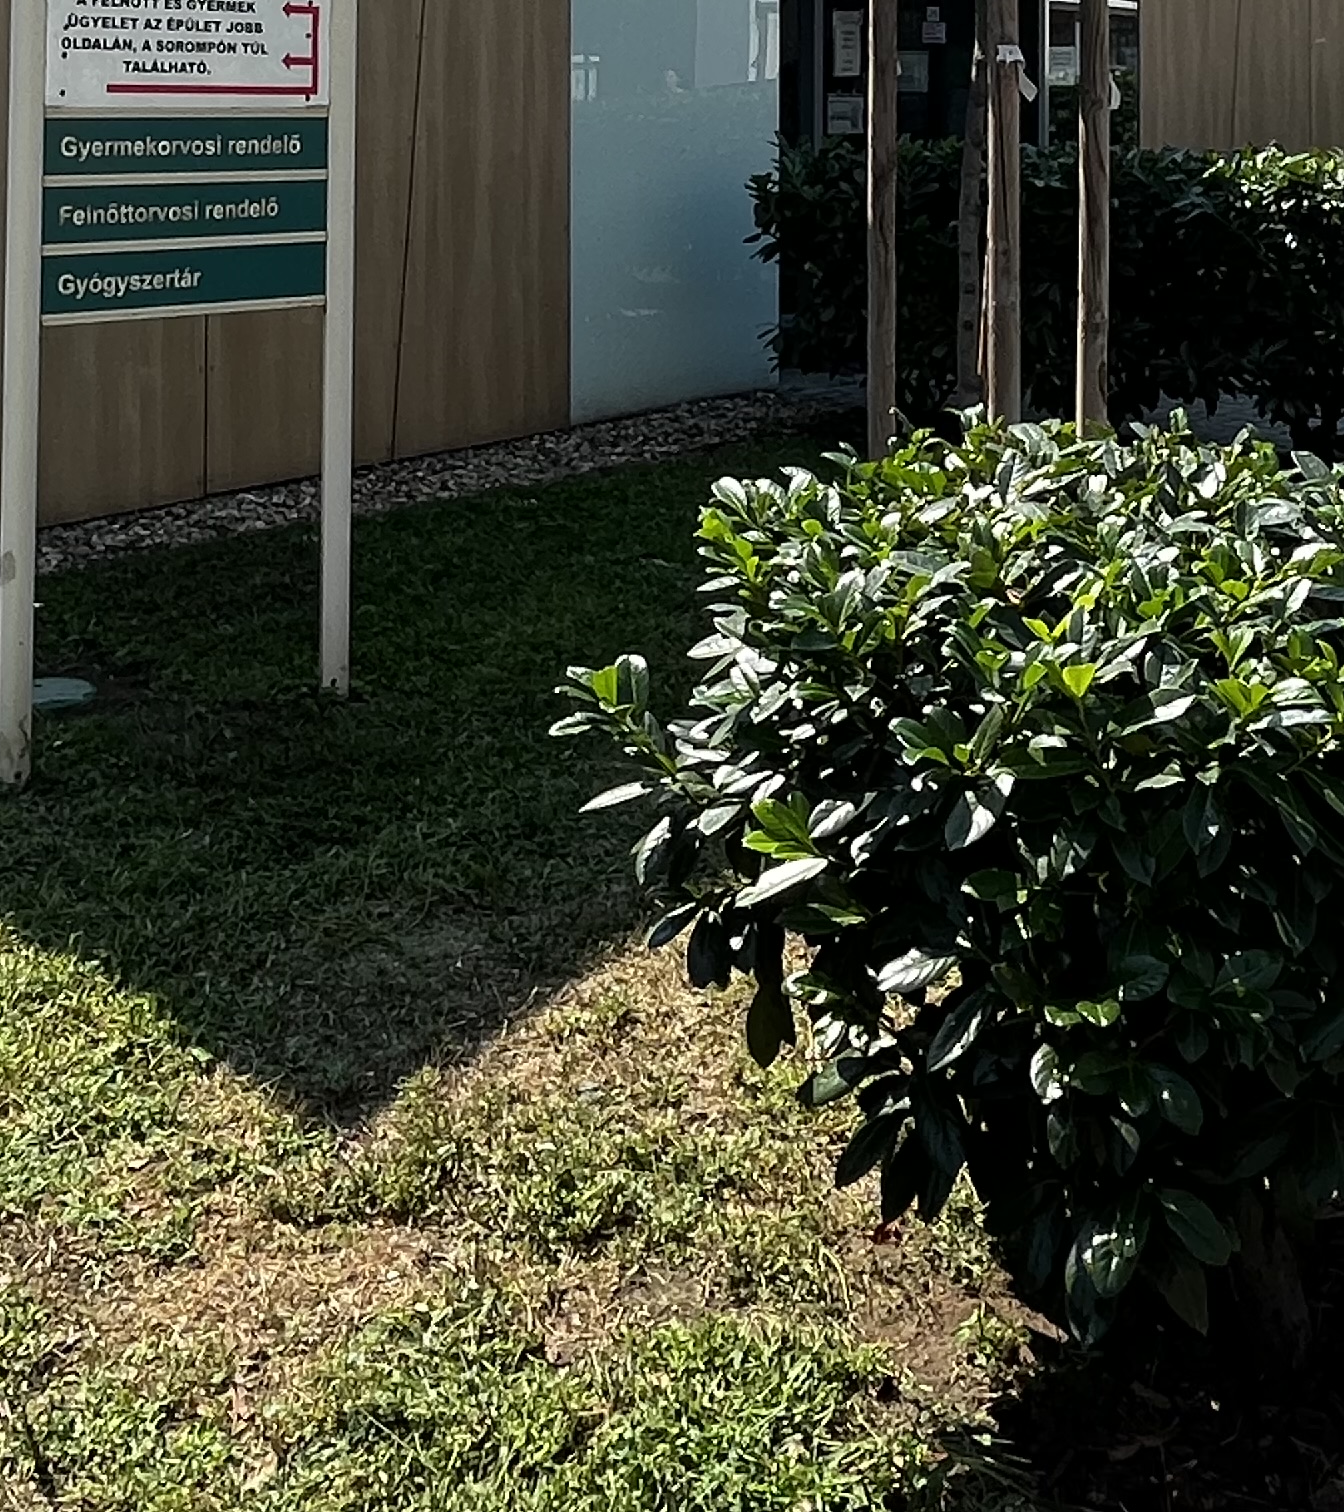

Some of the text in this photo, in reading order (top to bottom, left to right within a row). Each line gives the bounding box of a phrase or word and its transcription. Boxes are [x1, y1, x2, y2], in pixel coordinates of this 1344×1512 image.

[186, 0, 256, 14] GYERMEK
[143, 19, 162, 31] AZ
[226, 21, 264, 35] JOBB
[142, 39, 152, 52] A
[60, 133, 302, 161] Gyermekorvosi rendelő
[59, 195, 279, 226] Felnőttorvosi rendelő
[58, 266, 202, 300] Gyógyszertár
